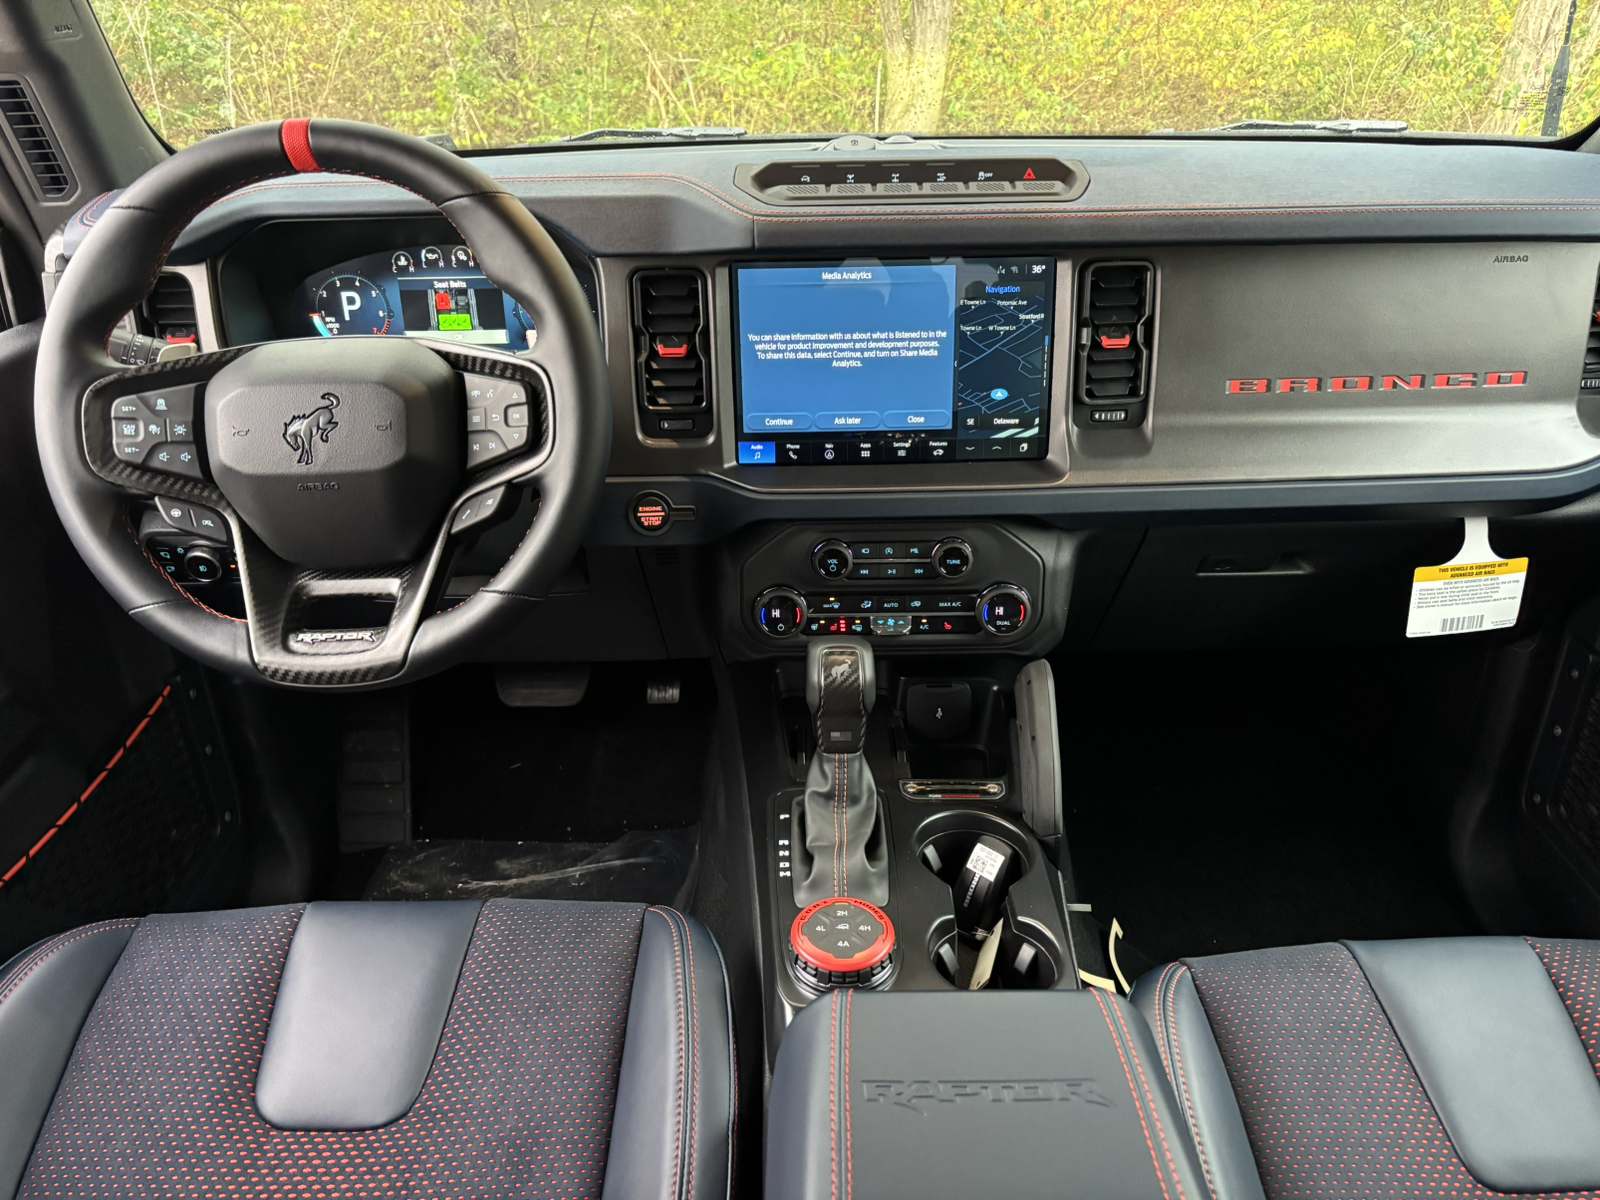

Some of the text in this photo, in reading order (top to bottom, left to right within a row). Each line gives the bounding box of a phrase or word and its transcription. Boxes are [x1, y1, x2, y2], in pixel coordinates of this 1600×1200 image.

[1493, 254, 1529, 263] AIRBAG
[842, 271, 872, 280] Analytics
[986, 285, 1020, 294] Navigation
[340, 291, 361, 321] P
[895, 330, 920, 338] listened
[787, 342, 811, 351] product
[813, 342, 854, 350] improvement
[868, 340, 908, 349] development
[833, 350, 863, 358] Continue,
[832, 360, 862, 368] Analytics.
[1225, 370, 1528, 395] BRONCO
[297, 482, 340, 491] AIRBAG
[772, 608, 780, 618] HI
[995, 606, 1003, 615] HI
[296, 631, 376, 644] RAPTOR
[854, 900, 884, 920] MODES
[860, 1078, 1117, 1116] RAPTOR
